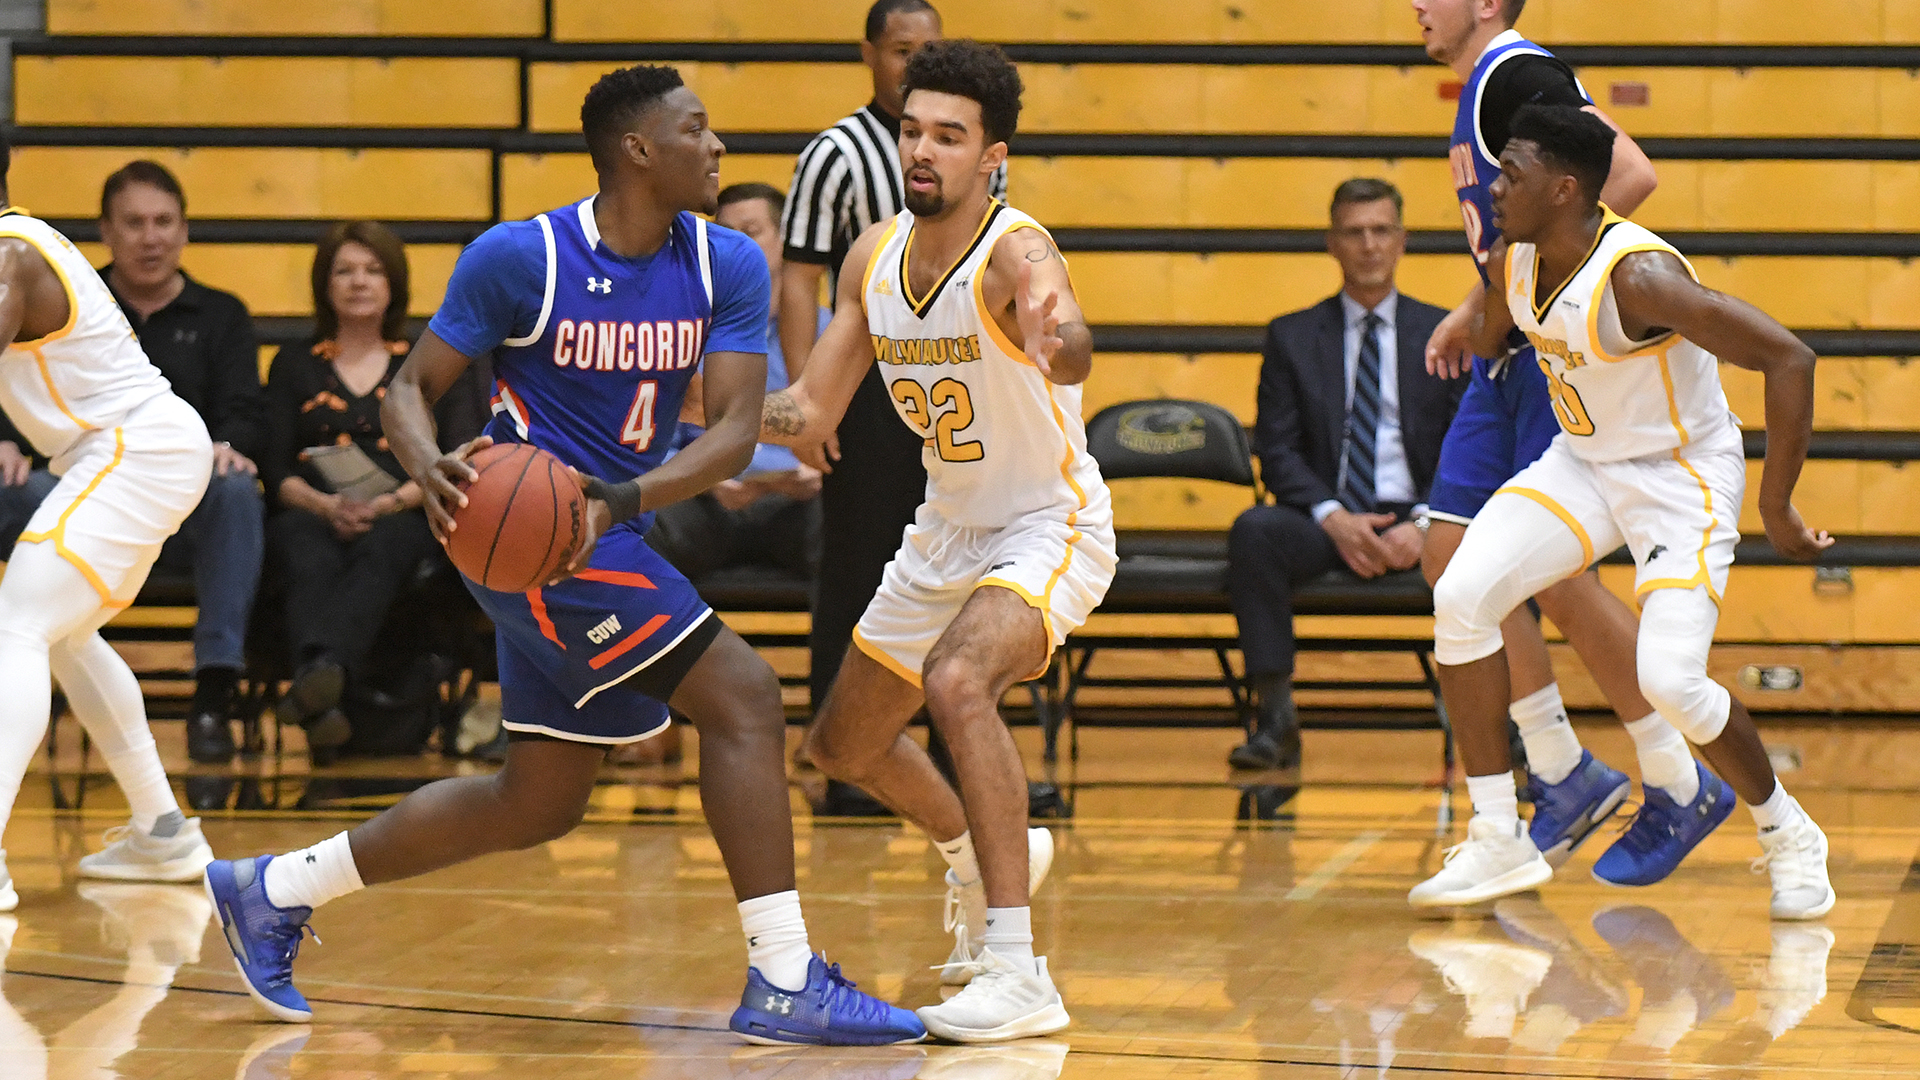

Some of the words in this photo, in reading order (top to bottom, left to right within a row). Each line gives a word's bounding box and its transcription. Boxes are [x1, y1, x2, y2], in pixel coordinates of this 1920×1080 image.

[554, 318, 709, 371] CONCORDI
[871, 334, 981, 366] MLWAUKEE
[620, 380, 657, 453] 4
[891, 377, 985, 462] 22
[587, 614, 622, 644] CUW
